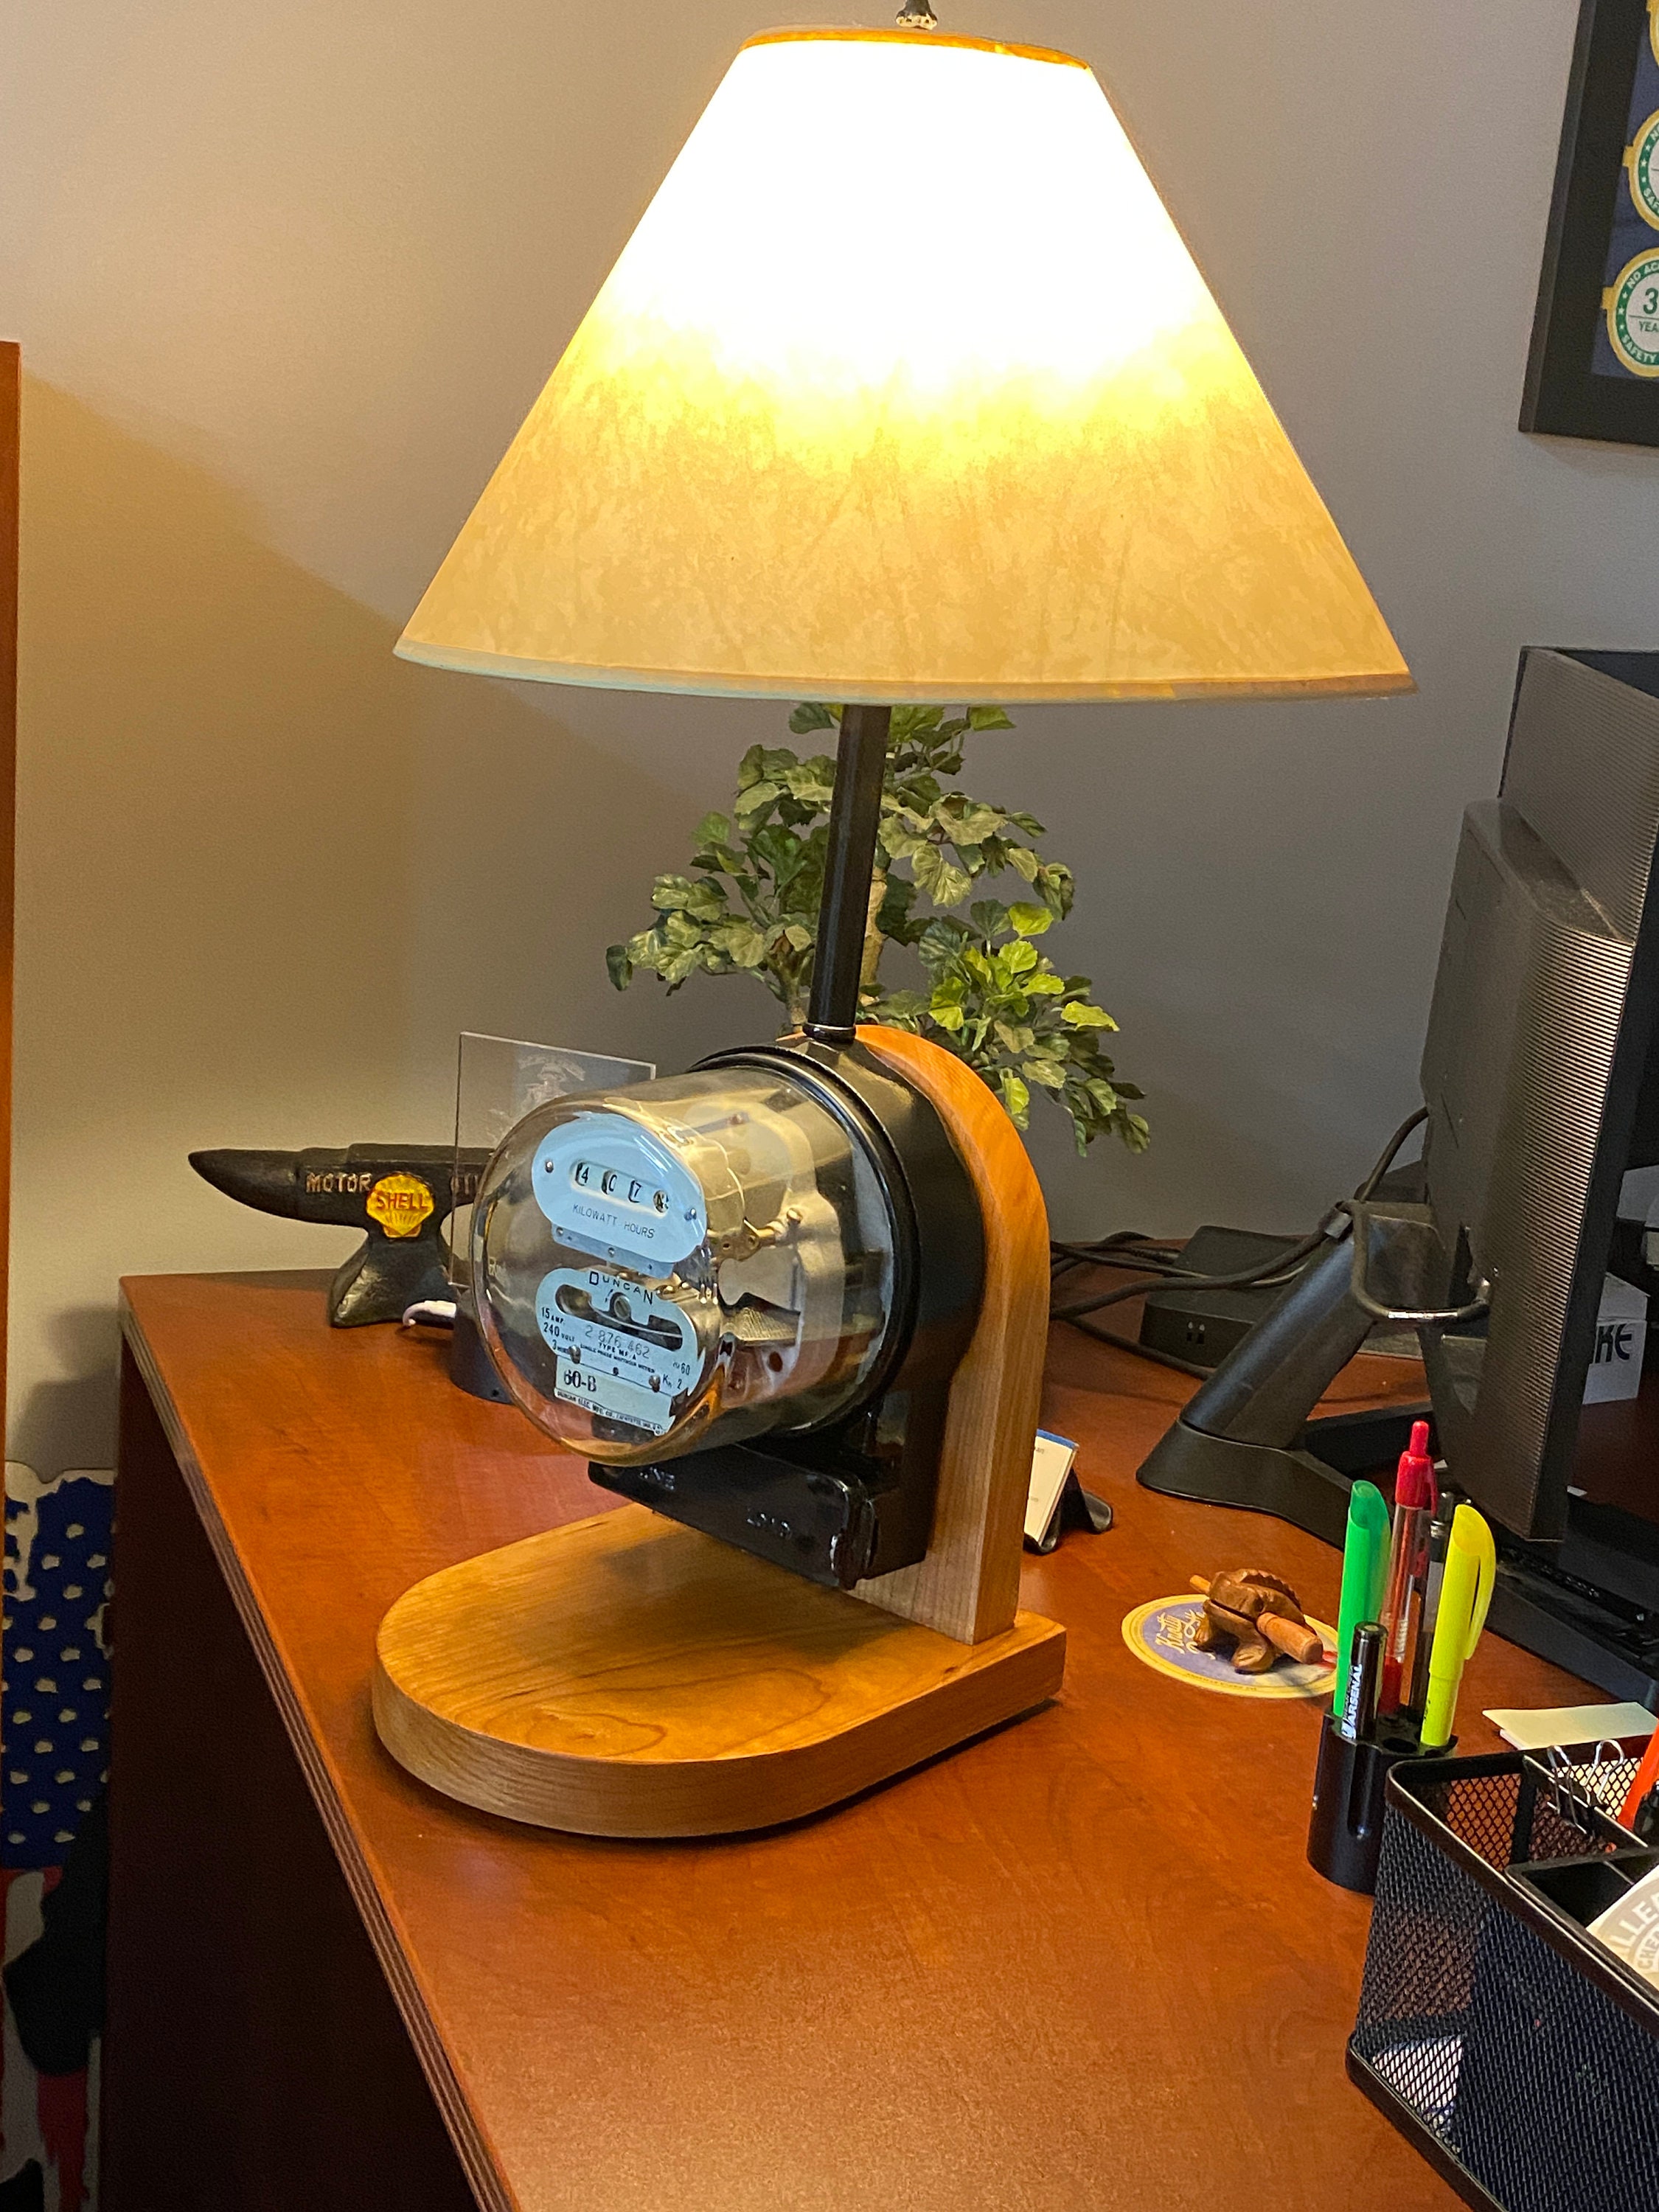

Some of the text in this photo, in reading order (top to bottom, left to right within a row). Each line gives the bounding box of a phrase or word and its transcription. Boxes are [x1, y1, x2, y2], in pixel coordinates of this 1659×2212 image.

[1644, 187, 1659, 215] SAF
[1627, 262, 1659, 288] NO AC
[1643, 288, 1659, 315] 3
[1621, 334, 1657, 364] SAFETY
[305, 1173, 372, 1193] MOTOR
[376, 1192, 428, 1210] SHELL
[572, 1203, 655, 1239] KILOWATT HOURS
[589, 1270, 653, 1305] DUNCAN
[541, 1307, 550, 1320] 15
[543, 1322, 575, 1343] 240 VOLT
[599, 1342, 616, 1353] TYPE
[563, 1369, 597, 1392] 60-B
[1347, 1663, 1363, 1726] ARSENAL
